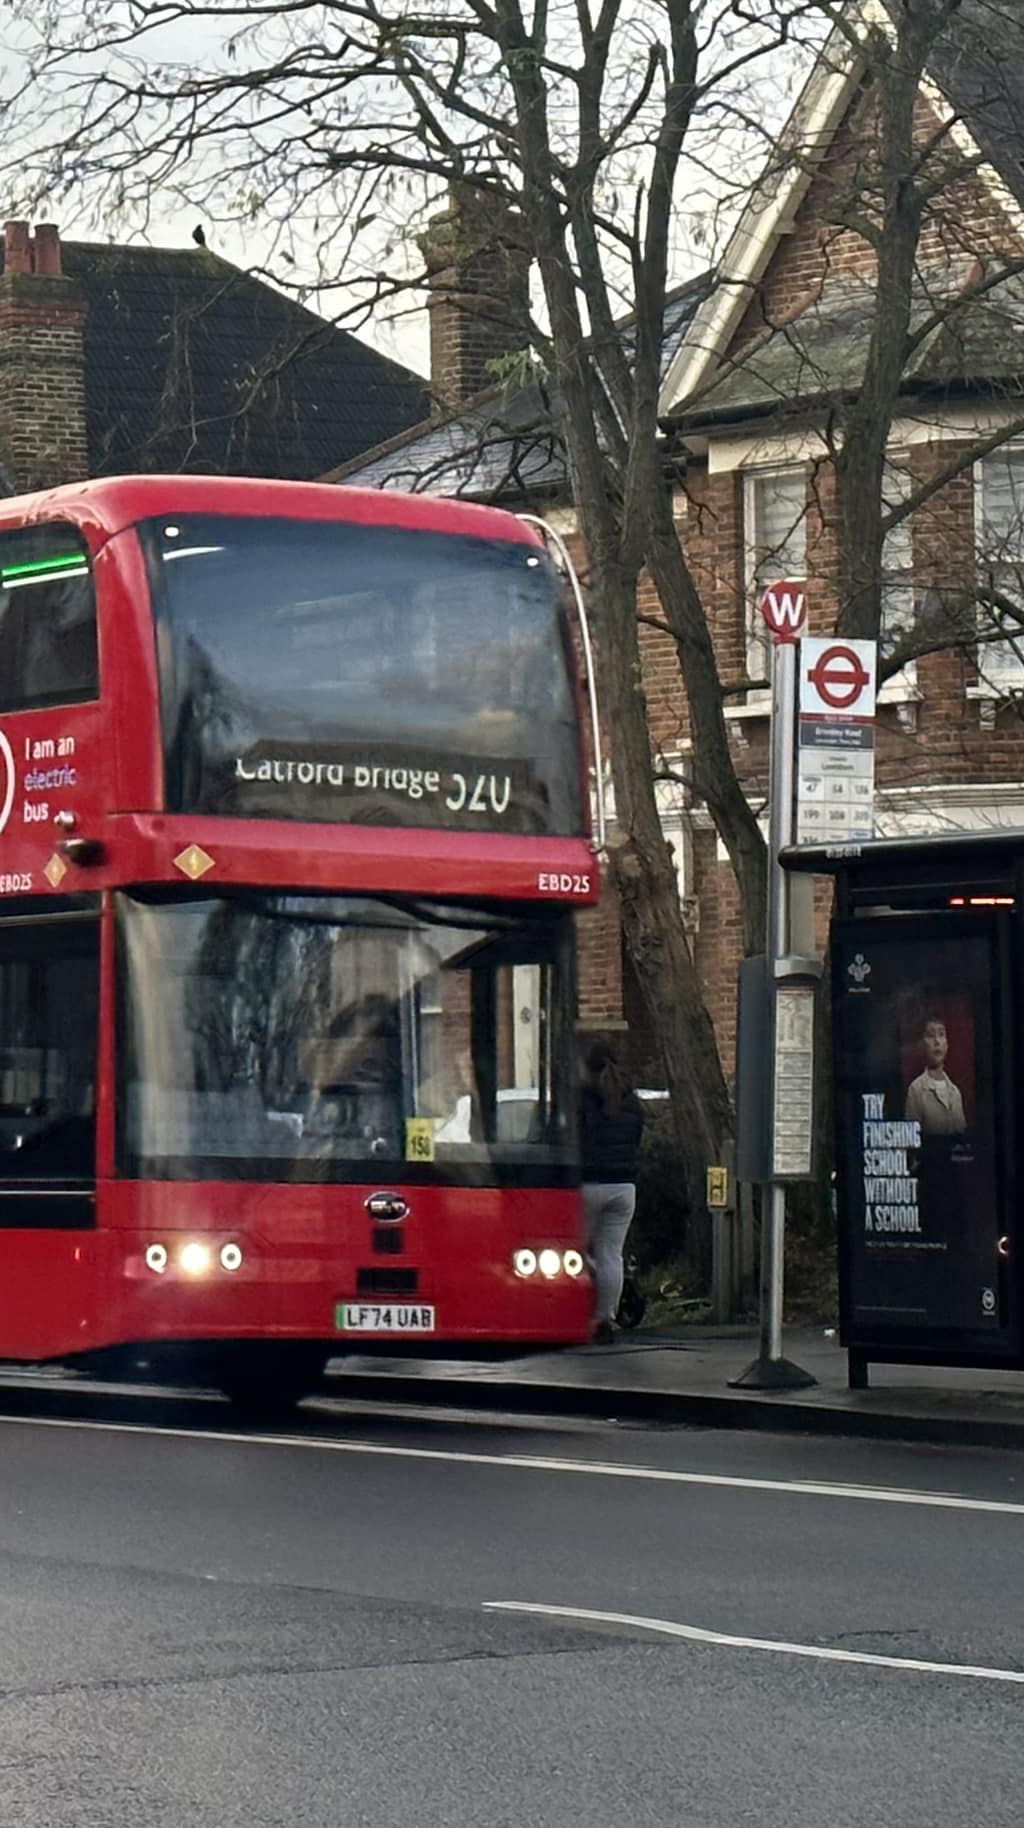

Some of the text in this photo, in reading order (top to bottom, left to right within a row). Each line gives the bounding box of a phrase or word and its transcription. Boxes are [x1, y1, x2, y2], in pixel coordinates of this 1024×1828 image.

[768, 592, 804, 627] W
[25, 736, 75, 761] I am an
[24, 764, 77, 792] electric
[805, 783, 818, 793] 47
[24, 800, 49, 823] bus
[538, 873, 590, 893] EBD25
[861, 1093, 885, 1119] TRY
[863, 1121, 921, 1148] FINISHING
[863, 1149, 910, 1176] SCHOOL
[863, 1176, 919, 1204] WITHOUT
[864, 1204, 922, 1233] A SCHOOL
[346, 1308, 431, 1328] LF74 UAB
